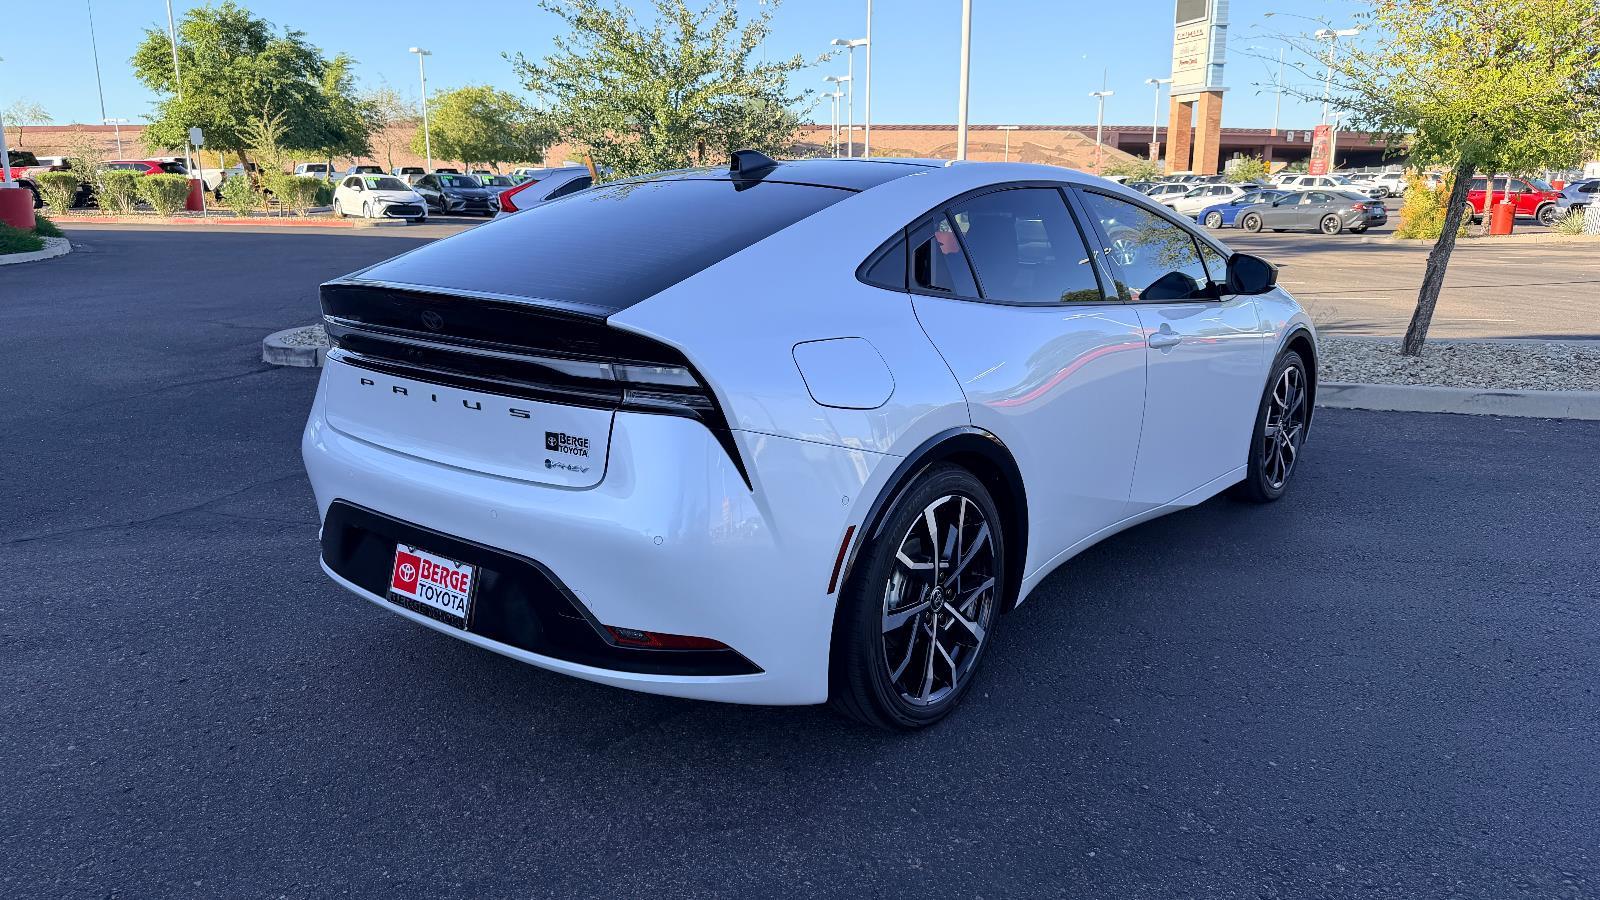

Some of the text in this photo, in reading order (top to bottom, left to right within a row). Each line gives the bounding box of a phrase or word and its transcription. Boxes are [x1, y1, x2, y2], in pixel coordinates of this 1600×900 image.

[361, 377, 531, 419] PRIUS
[559, 432, 589, 448] BERGE
[559, 443, 588, 458] TOYOTA
[421, 558, 469, 594] BERGE
[419, 582, 465, 614] TOYOTA
